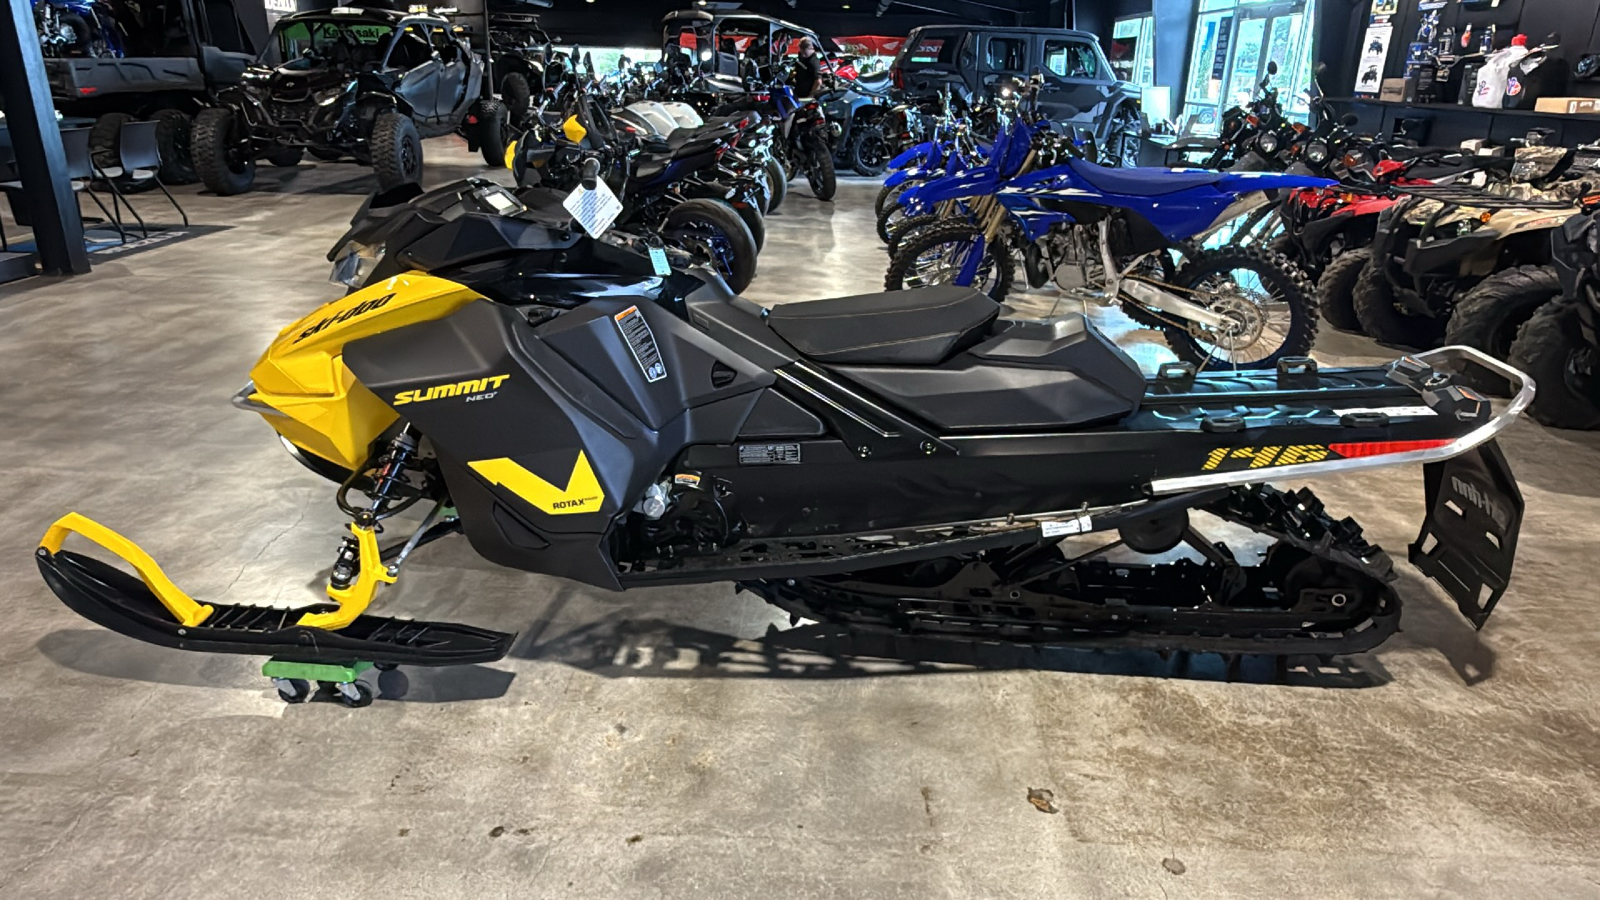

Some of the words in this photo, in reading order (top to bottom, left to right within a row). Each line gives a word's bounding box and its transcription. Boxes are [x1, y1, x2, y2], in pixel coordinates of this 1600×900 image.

[323, 26, 379, 39] Kasaki
[292, 293, 397, 345] ski-doo
[393, 374, 510, 406] SUMMIT
[1202, 444, 1330, 471] 146
[552, 498, 585, 509] ROTAX
